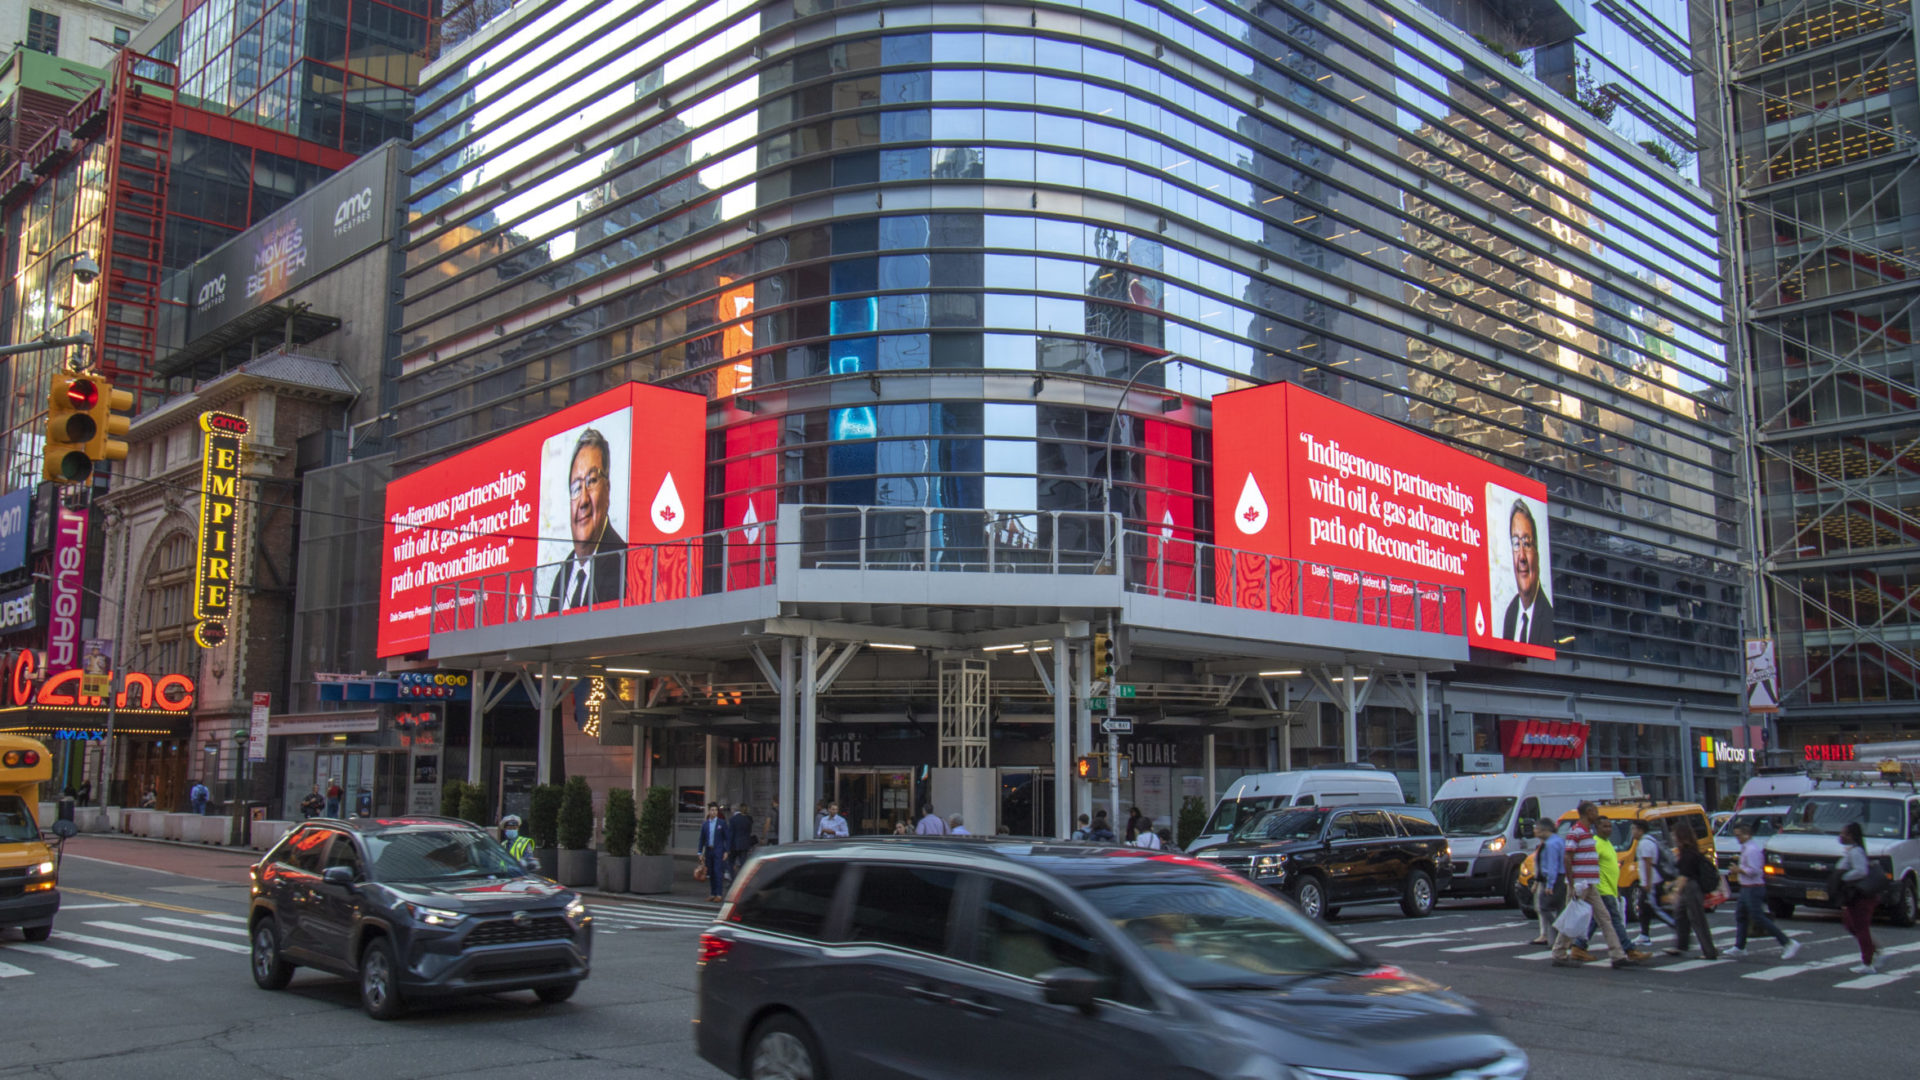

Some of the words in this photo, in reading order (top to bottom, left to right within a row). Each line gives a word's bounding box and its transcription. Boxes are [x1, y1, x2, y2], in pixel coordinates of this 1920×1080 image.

[334, 211, 371, 238] THEATRES
[335, 187, 372, 226] amc
[254, 228, 303, 271] MOVIES
[199, 273, 226, 304] amc
[247, 246, 308, 299] BETTER
[212, 415, 247, 433] amc
[450, 469, 526, 520] partnerships
[1308, 475, 1345, 508] with
[1348, 486, 1367, 514] oil
[1369, 492, 1381, 519] &
[1383, 500, 1406, 527] gas
[1407, 505, 1460, 541] advance
[1461, 519, 1481, 547] the
[1393, 469, 1474, 517] partnerships
[0, 505, 21, 538] om
[207, 448, 236, 607] EMPIRE
[393, 538, 415, 563] with
[416, 530, 430, 556] oil
[430, 529, 440, 552] &
[440, 526, 459, 554] gas
[459, 510, 509, 543] advance
[509, 500, 531, 527] the
[1309, 516, 1347, 545] path
[1349, 522, 1366, 550] of
[51, 514, 84, 667] IT'SUGAR
[391, 565, 413, 599] path
[414, 561, 427, 586] of
[55, 730, 104, 741] IMAX
[752, 741, 780, 763] TIM
[819, 741, 862, 763] UARE
[1127, 743, 1177, 764] SQUARE
